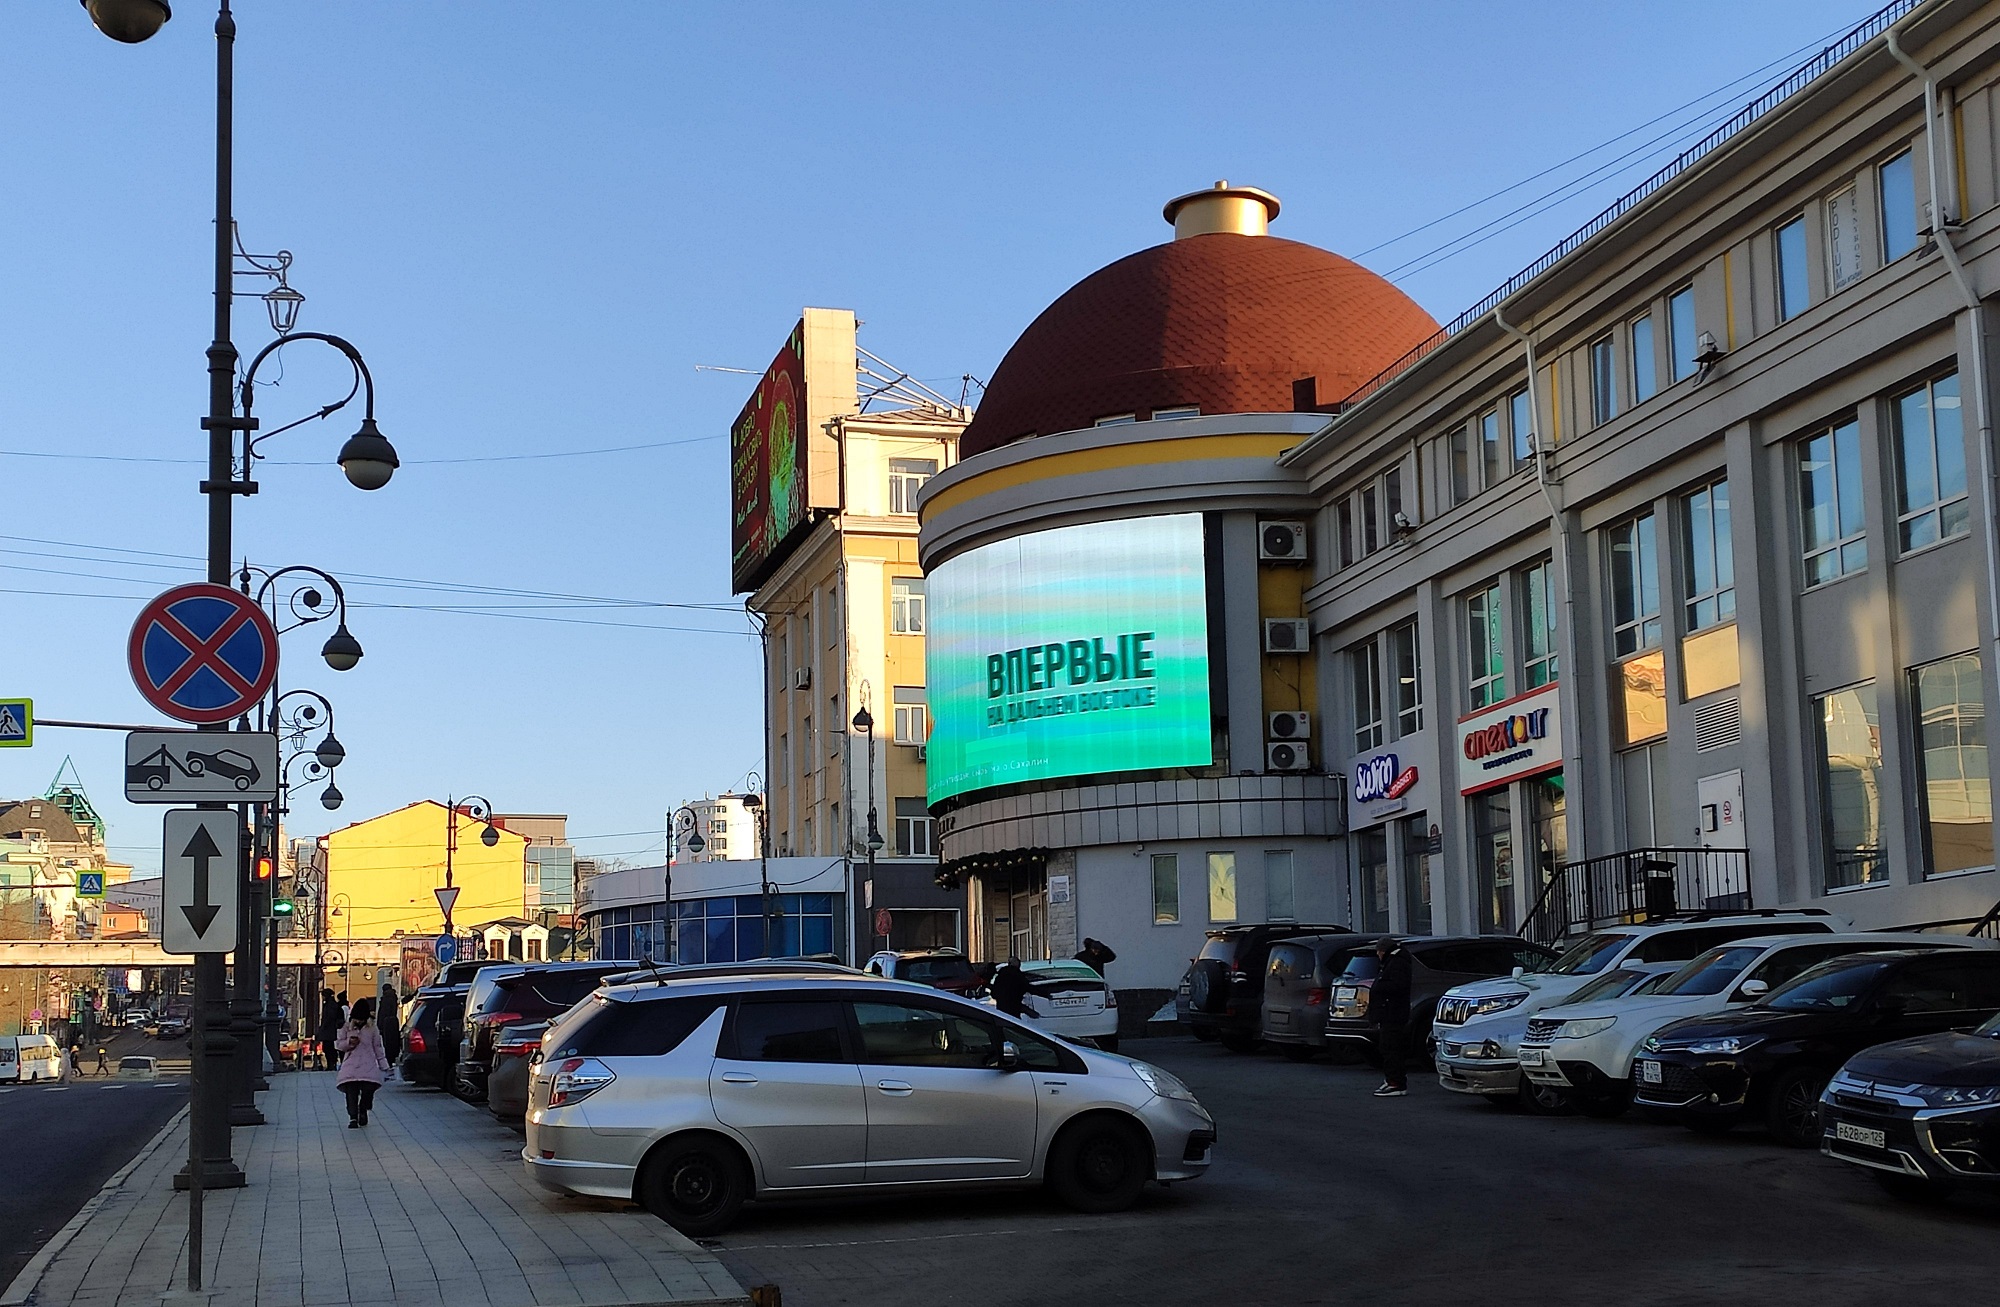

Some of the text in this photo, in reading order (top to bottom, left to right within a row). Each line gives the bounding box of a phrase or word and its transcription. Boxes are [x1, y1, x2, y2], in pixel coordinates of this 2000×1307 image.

[1831, 200, 1842, 280] PODIUM
[987, 632, 1156, 699] ВПЕРВЫЕ
[1010, 758, 1049, 770] Сахалин
